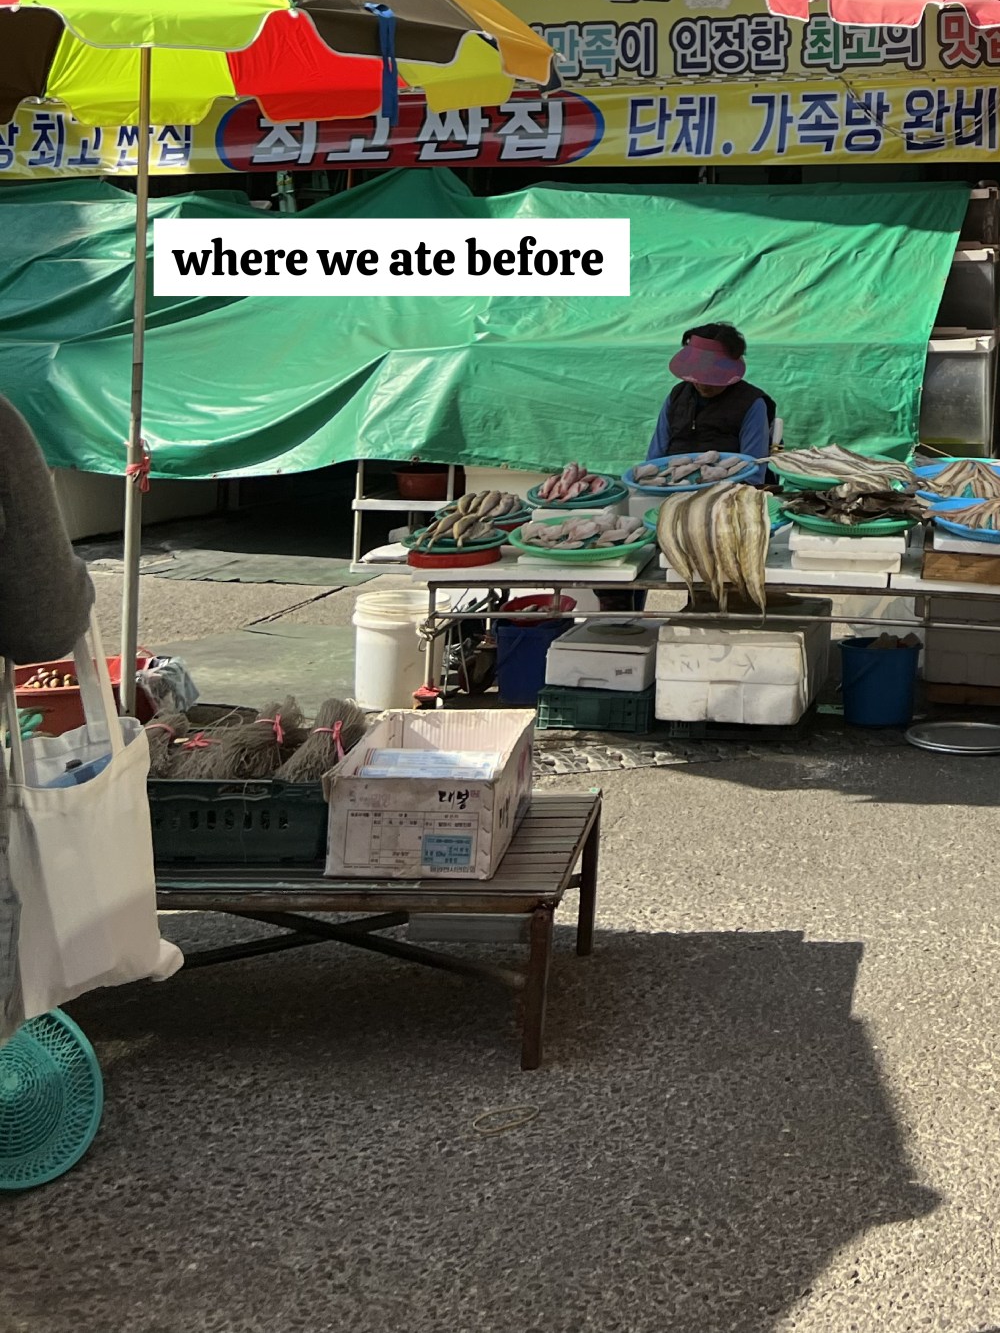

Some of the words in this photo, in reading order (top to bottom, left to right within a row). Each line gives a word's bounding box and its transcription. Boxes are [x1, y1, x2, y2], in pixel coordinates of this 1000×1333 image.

[533, 24, 652, 75] 만족이
[676, 18, 786, 72] 인정한
[808, 18, 919, 66] 최고의
[750, 90, 888, 156] 가족방
[904, 87, 999, 152] 완비
